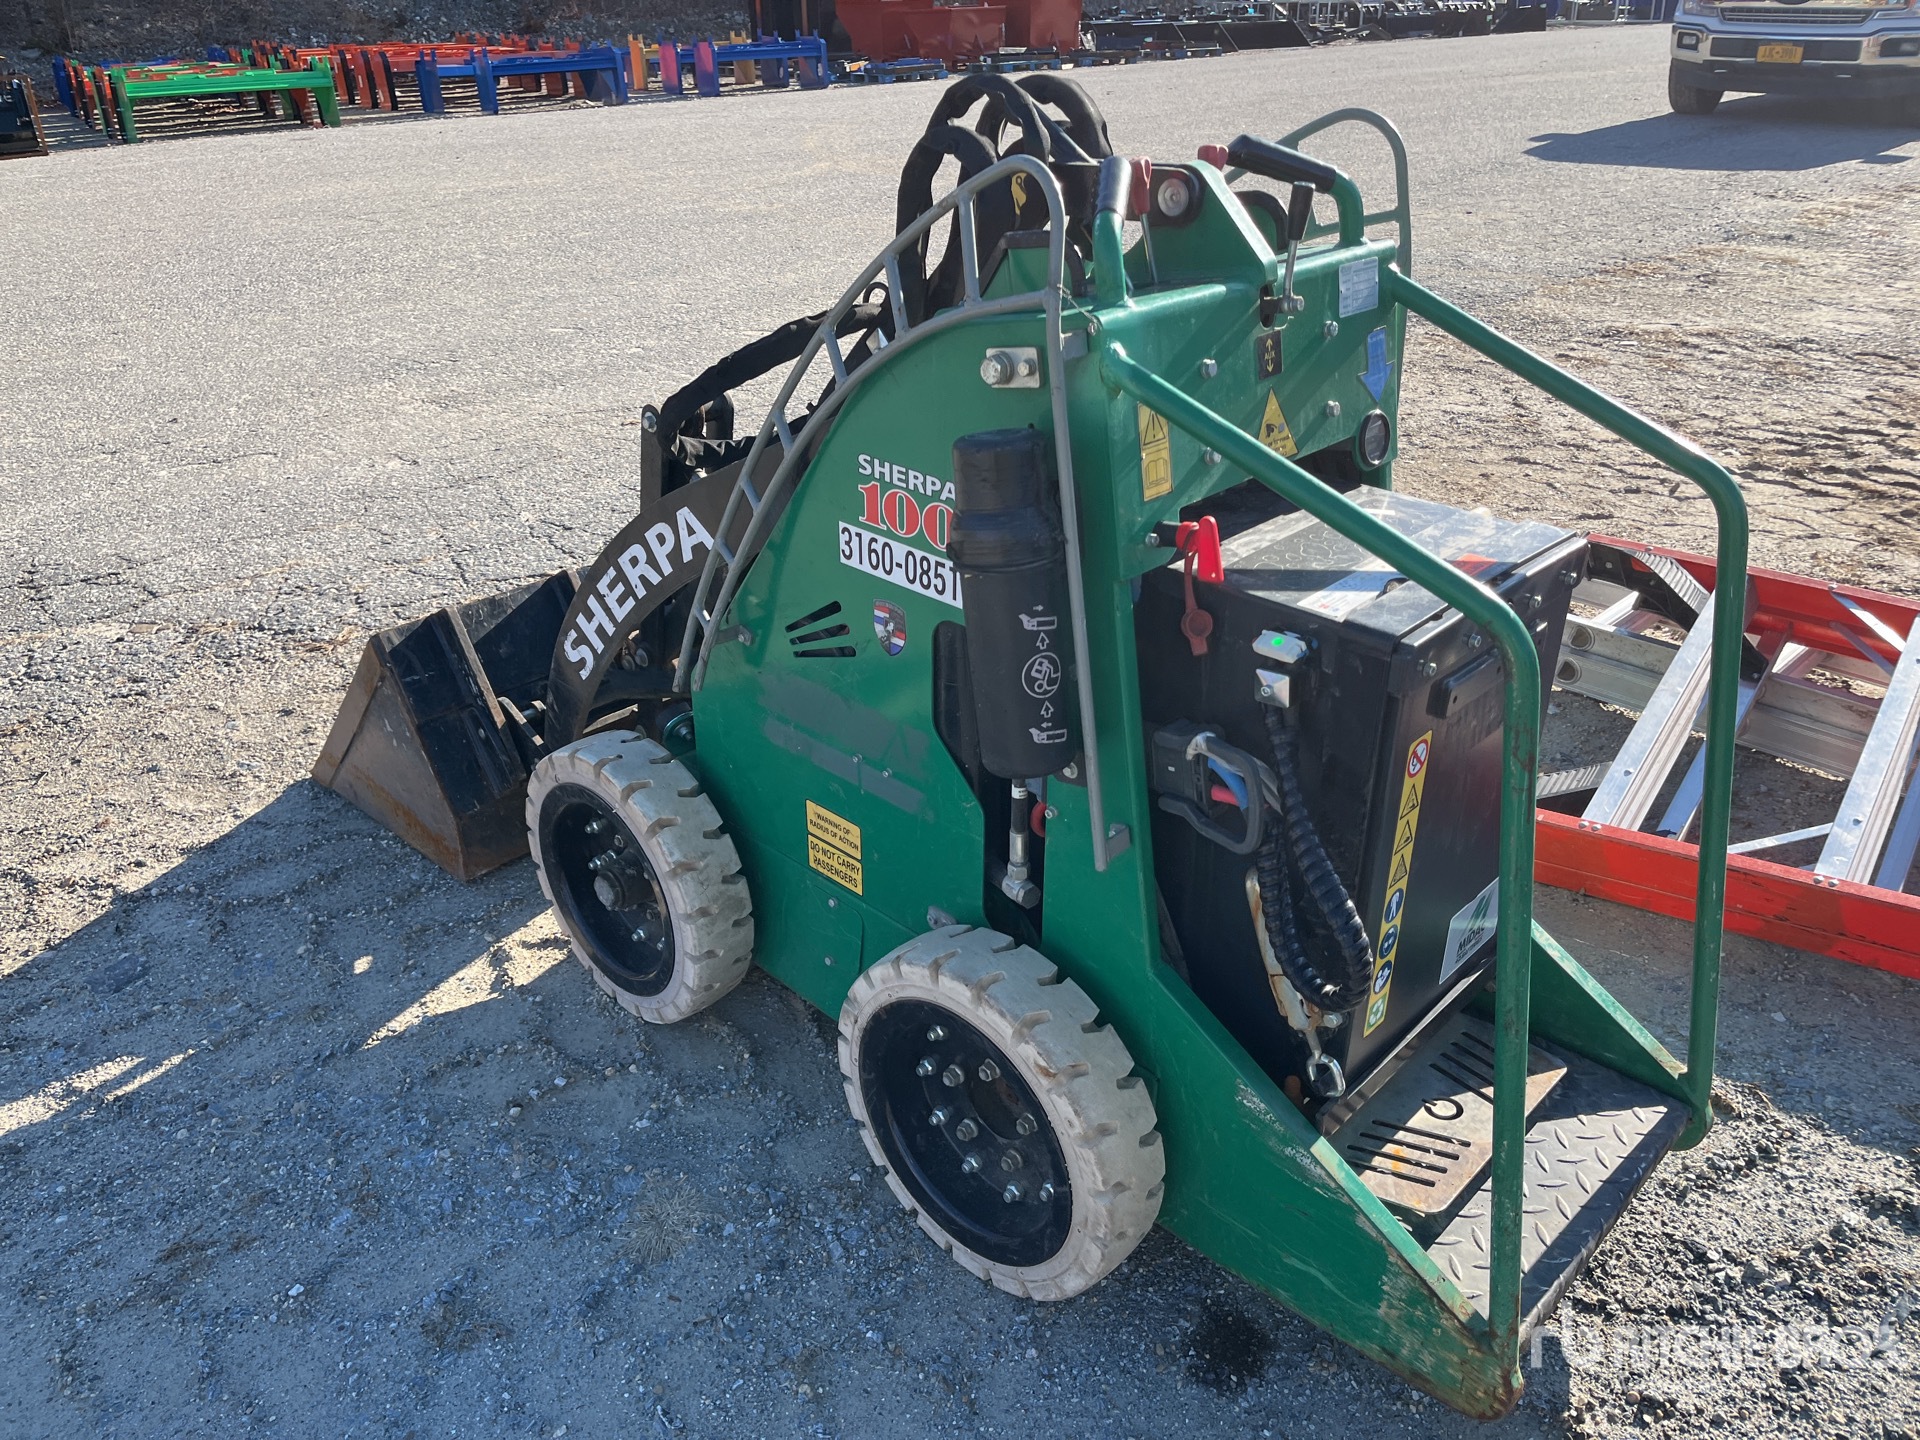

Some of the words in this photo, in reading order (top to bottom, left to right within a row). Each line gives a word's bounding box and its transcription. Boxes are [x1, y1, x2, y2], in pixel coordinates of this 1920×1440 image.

[1264, 351, 1275, 360] AUX
[858, 453, 956, 502] SHERPA
[840, 526, 958, 602] 3160-0851
[563, 506, 715, 680] SHERPA
[809, 819, 829, 834] RADIUS
[831, 830, 838, 839] OF
[839, 835, 859, 851] ACTION
[816, 813, 842, 831] WARNING
[843, 827, 851, 836] OF
[810, 841, 820, 853] DO
[821, 847, 836, 862] NOT
[836, 855, 860, 876] CARRY
[813, 855, 858, 888] PASSENGERS
